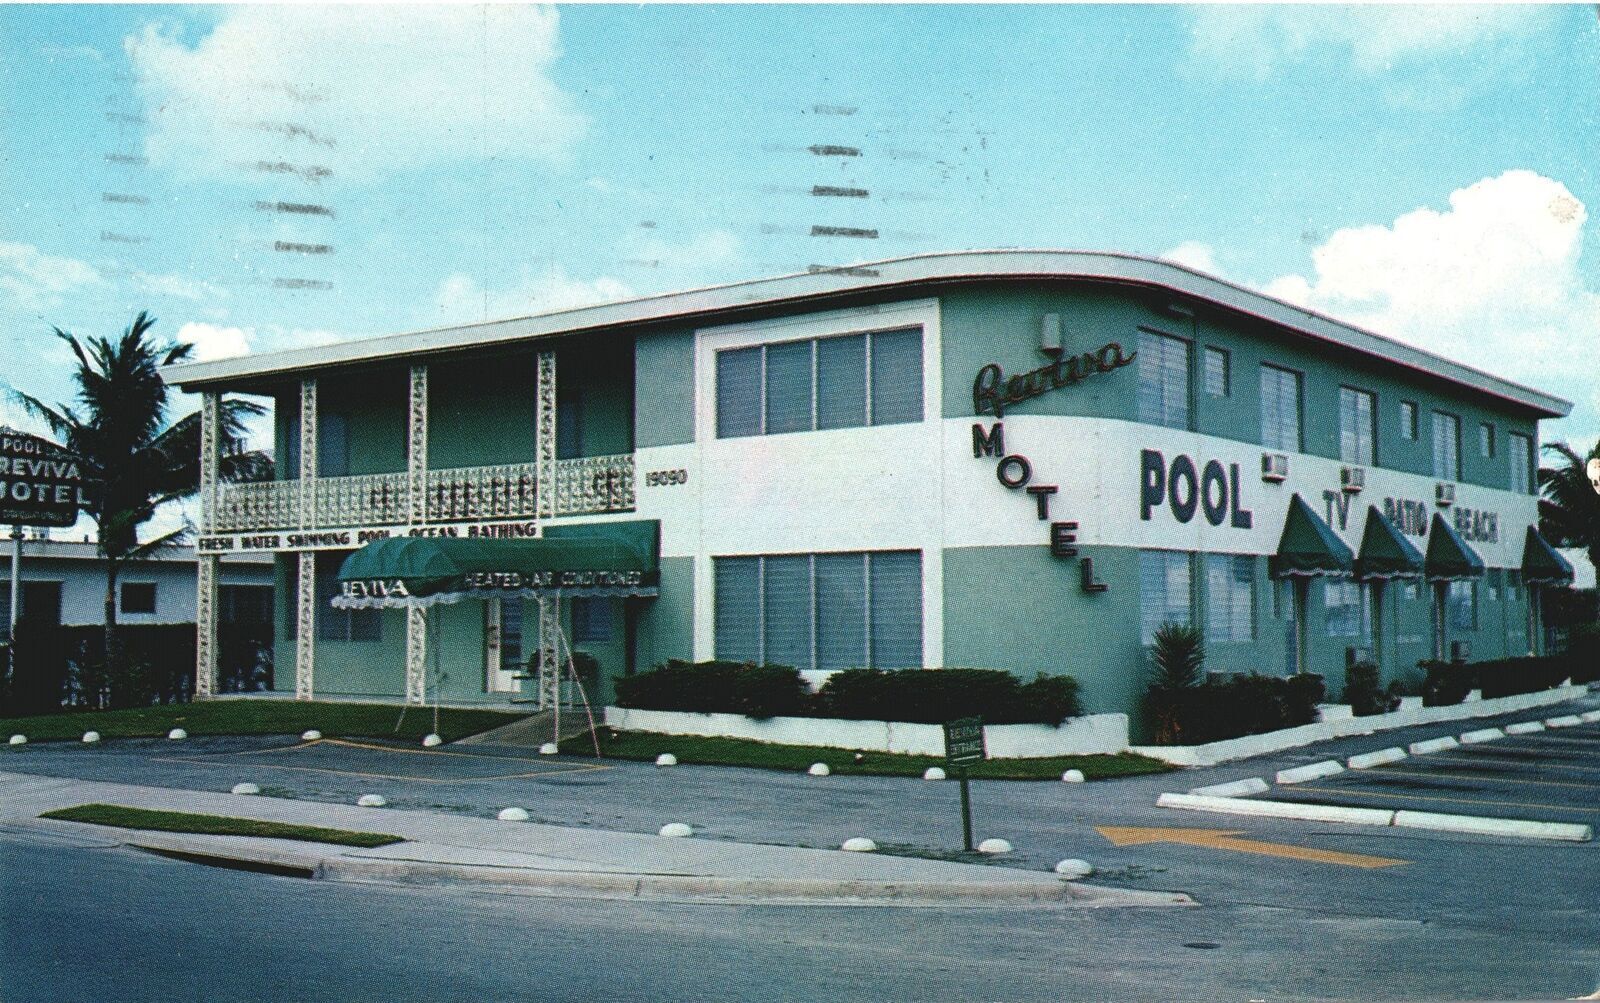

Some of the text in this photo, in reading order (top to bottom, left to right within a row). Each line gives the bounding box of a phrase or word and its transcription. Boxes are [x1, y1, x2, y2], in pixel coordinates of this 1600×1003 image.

[973, 341, 1138, 418] Reviva
[3, 437, 42, 454] POOL
[972, 421, 1109, 592] MOTEL
[1139, 448, 1499, 543] POOL TV PATIO BEACH
[199, 537, 234, 550] FRESH
[241, 535, 280, 548] WATER
[409, 527, 458, 538] OCEAN
[468, 522, 537, 538] BATHING
[464, 572, 521, 587] HEATED
[531, 571, 553, 586] AIR
